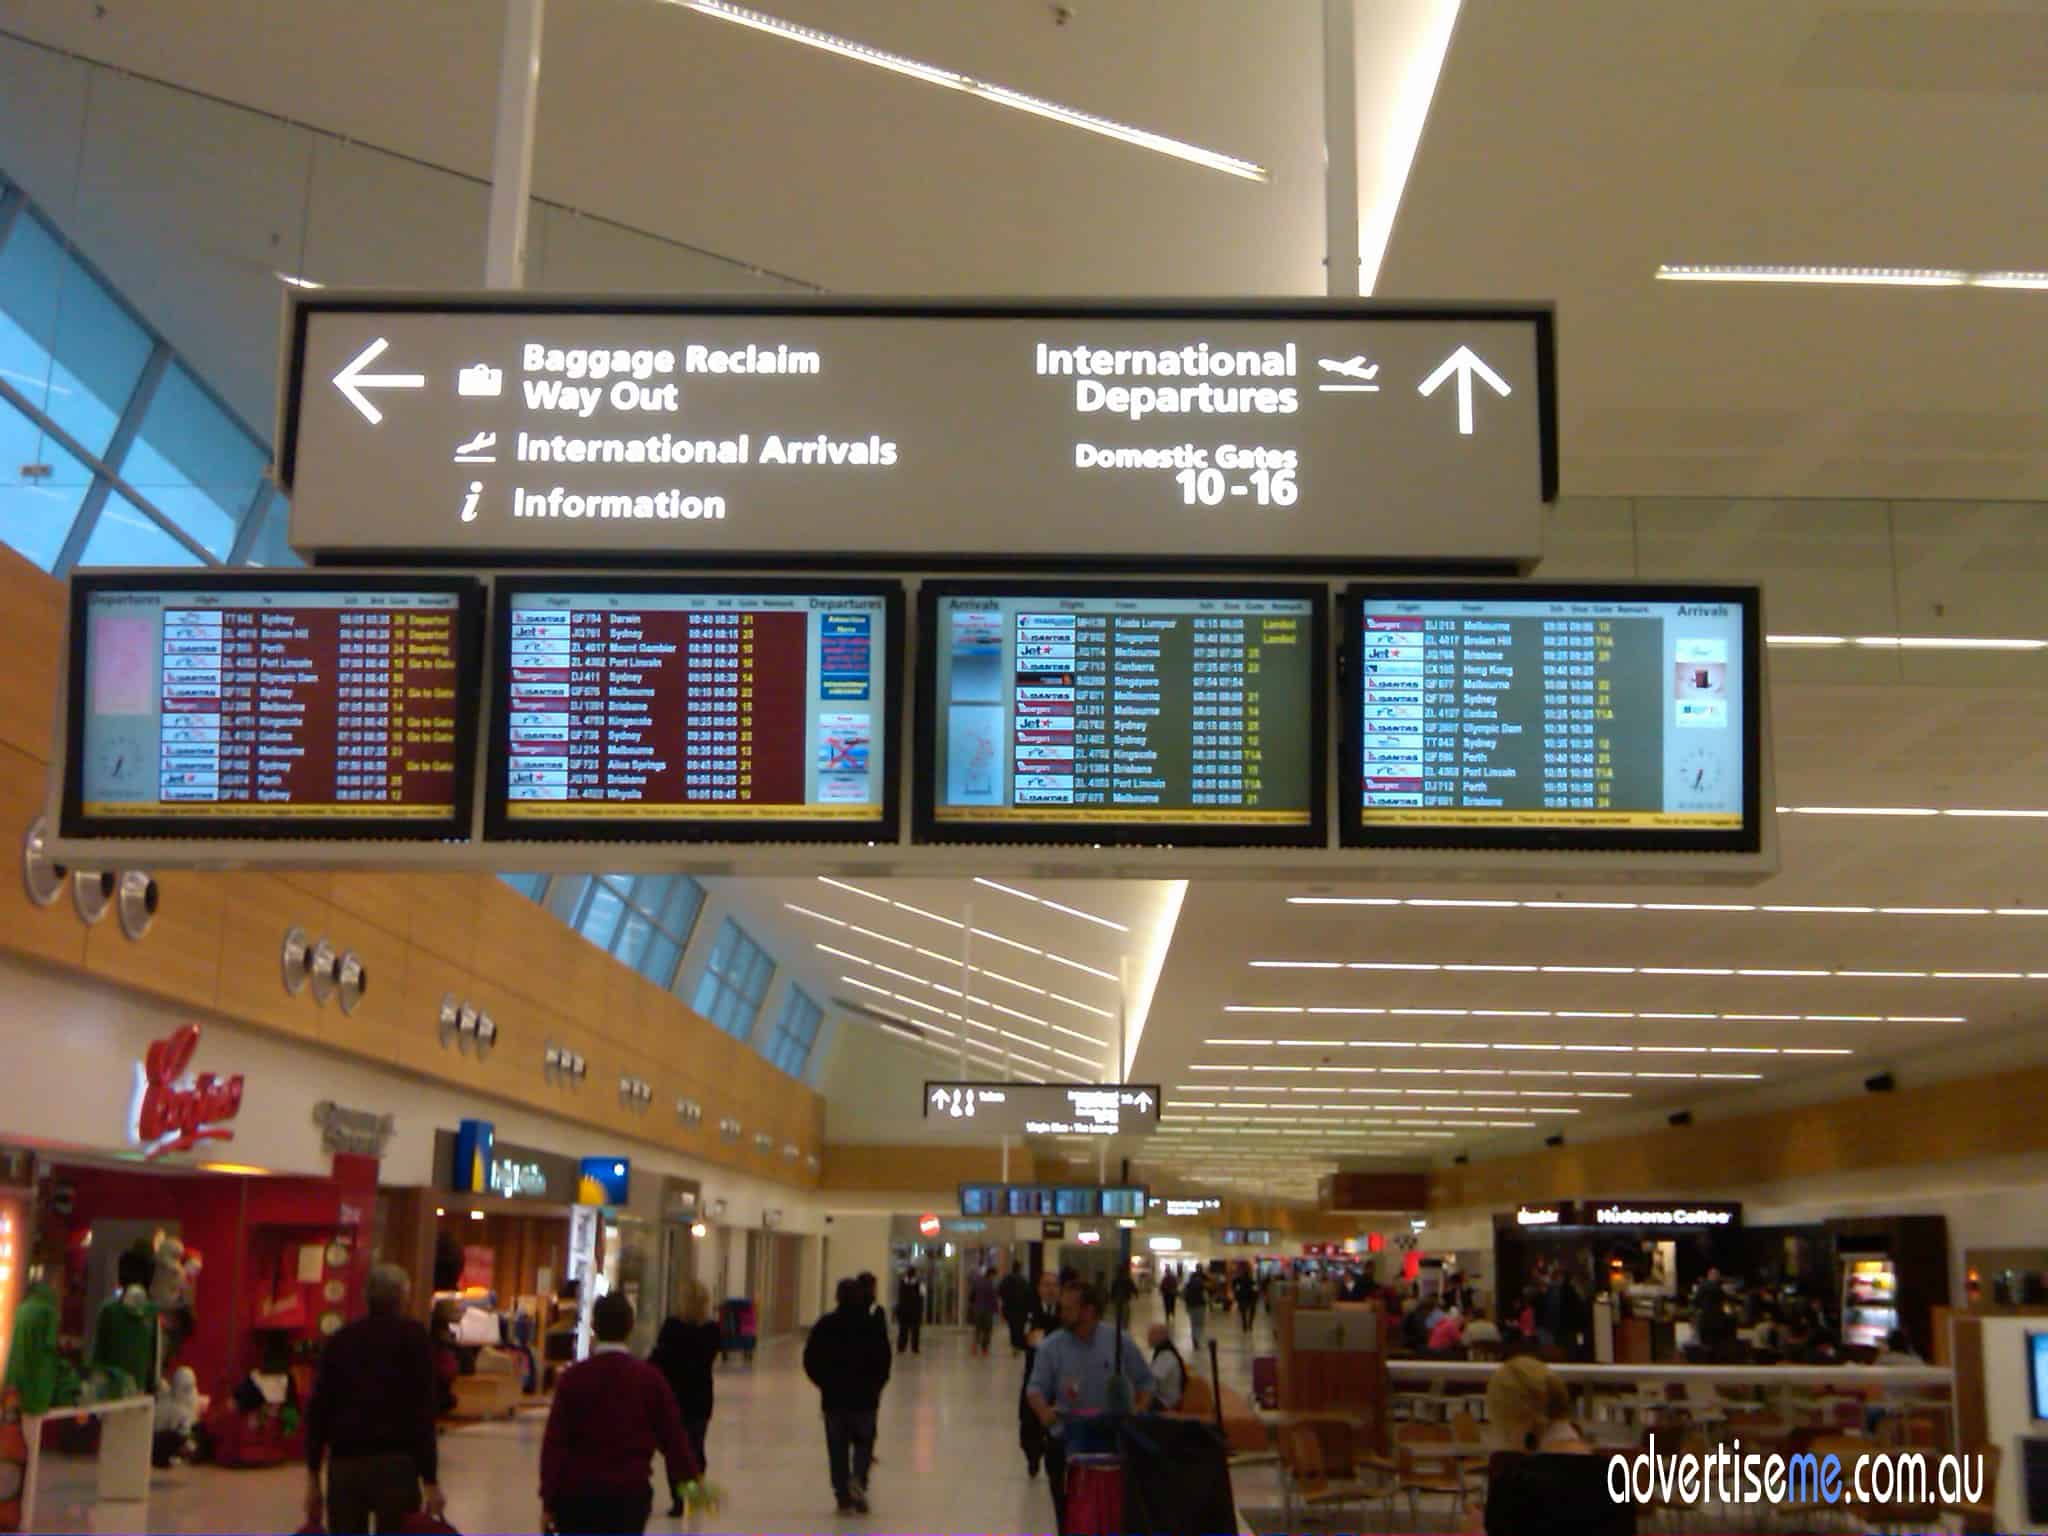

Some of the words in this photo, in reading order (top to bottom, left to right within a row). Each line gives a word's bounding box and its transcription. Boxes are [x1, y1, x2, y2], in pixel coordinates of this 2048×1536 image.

[523, 343, 676, 380] Baggage
[685, 343, 820, 374] Reclaim
[1036, 342, 1297, 377] International
[522, 380, 603, 418] Way
[610, 380, 679, 412] Out
[1076, 379, 1299, 421] Departures
[517, 431, 749, 464] International
[758, 434, 898, 466] Arrivals
[1075, 443, 1208, 468] Domestic
[1215, 445, 1298, 470] Gates
[514, 487, 726, 519] Information
[809, 596, 882, 611] Departures
[1677, 604, 1728, 618] Arrivals
[1369, 649, 1389, 660] Jet
